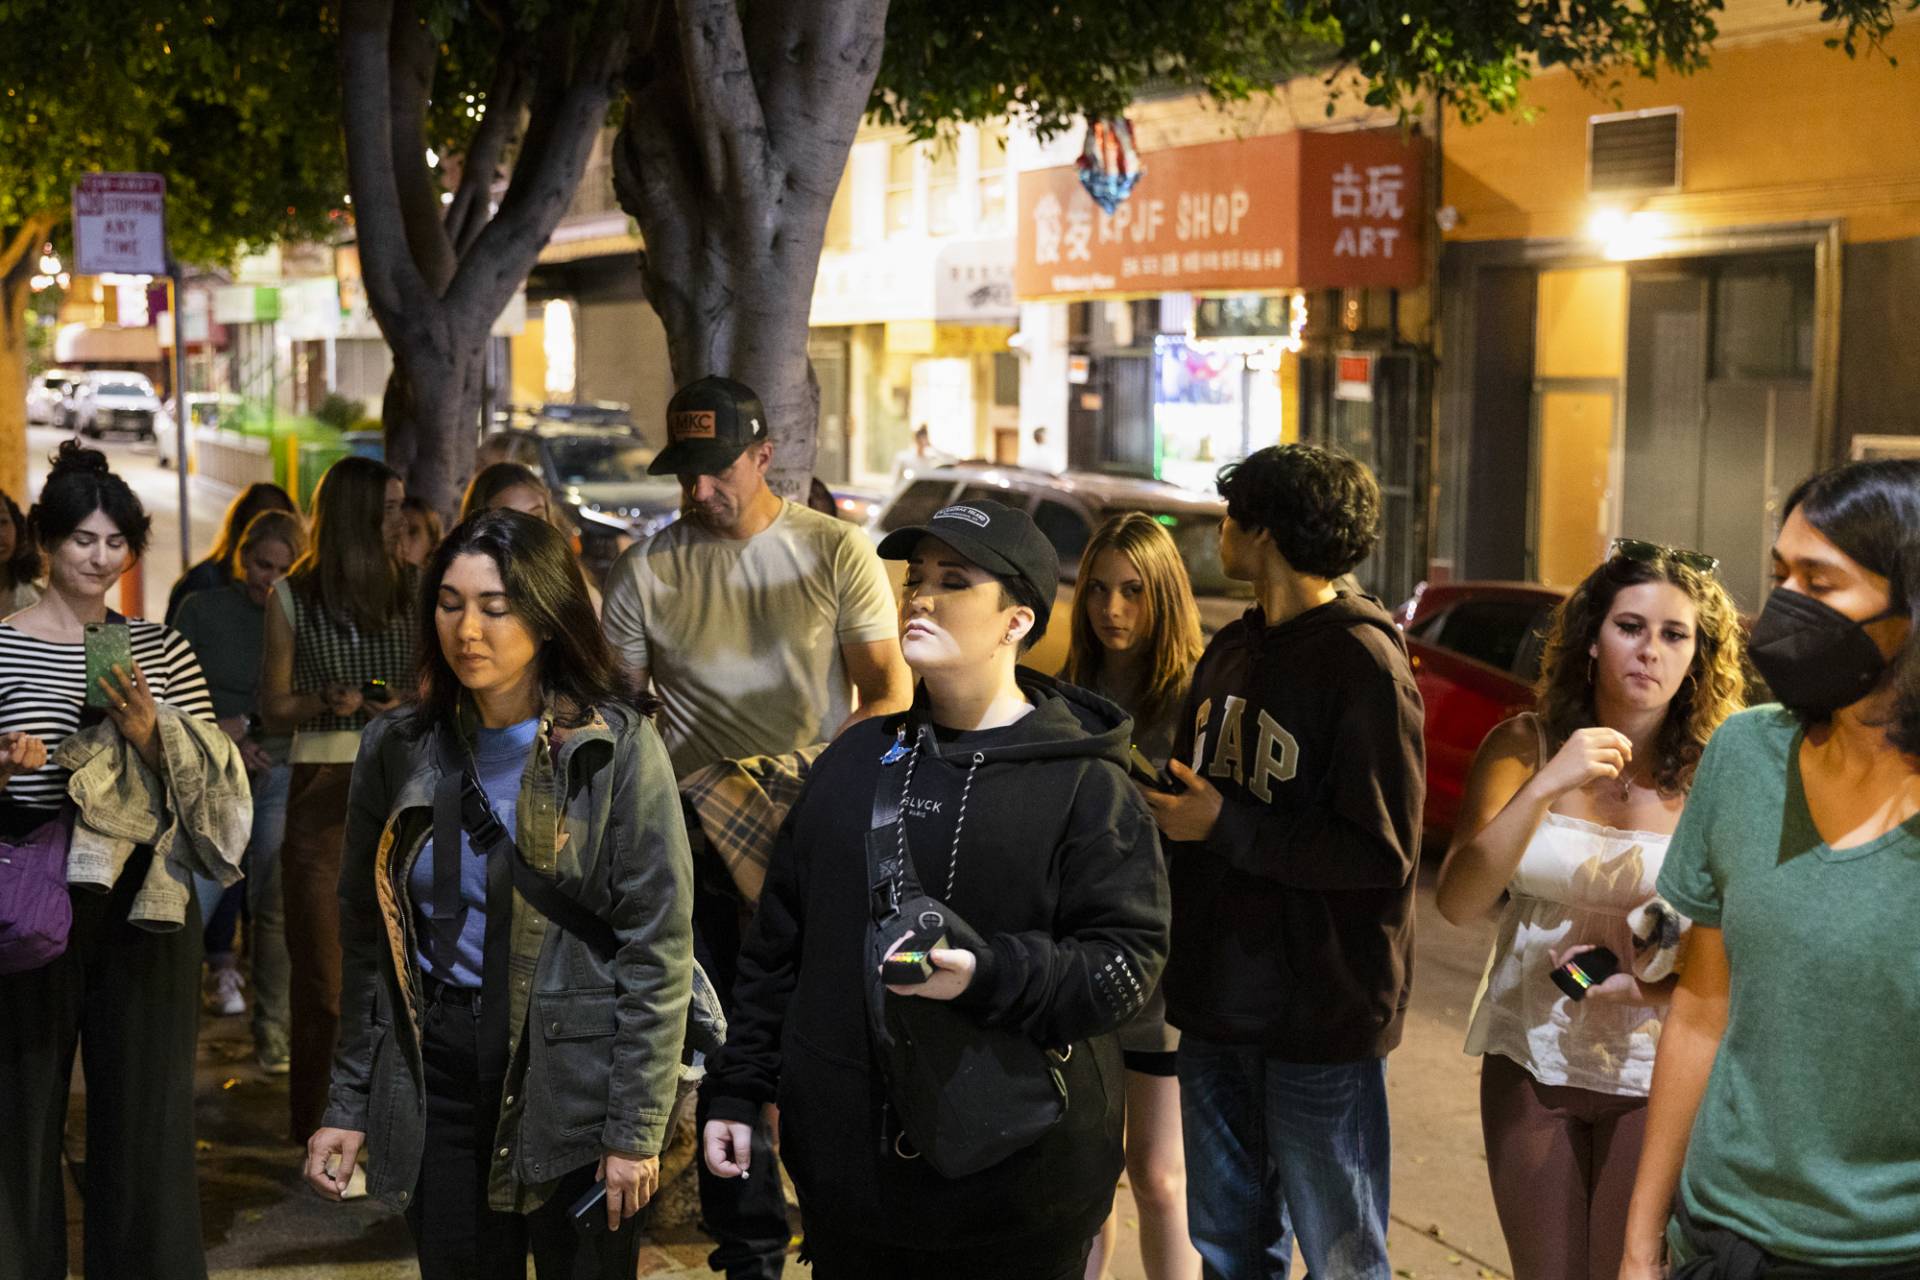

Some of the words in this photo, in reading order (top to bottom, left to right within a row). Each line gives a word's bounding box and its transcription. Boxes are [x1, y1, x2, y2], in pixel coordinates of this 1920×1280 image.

[1332, 163, 1403, 219] 古玩
[104, 198, 162, 213] STOPPING
[1176, 188, 1249, 241] SHOP
[104, 219, 137, 234] ANY
[103, 239, 139, 256] TIME
[1333, 227, 1400, 257] ART
